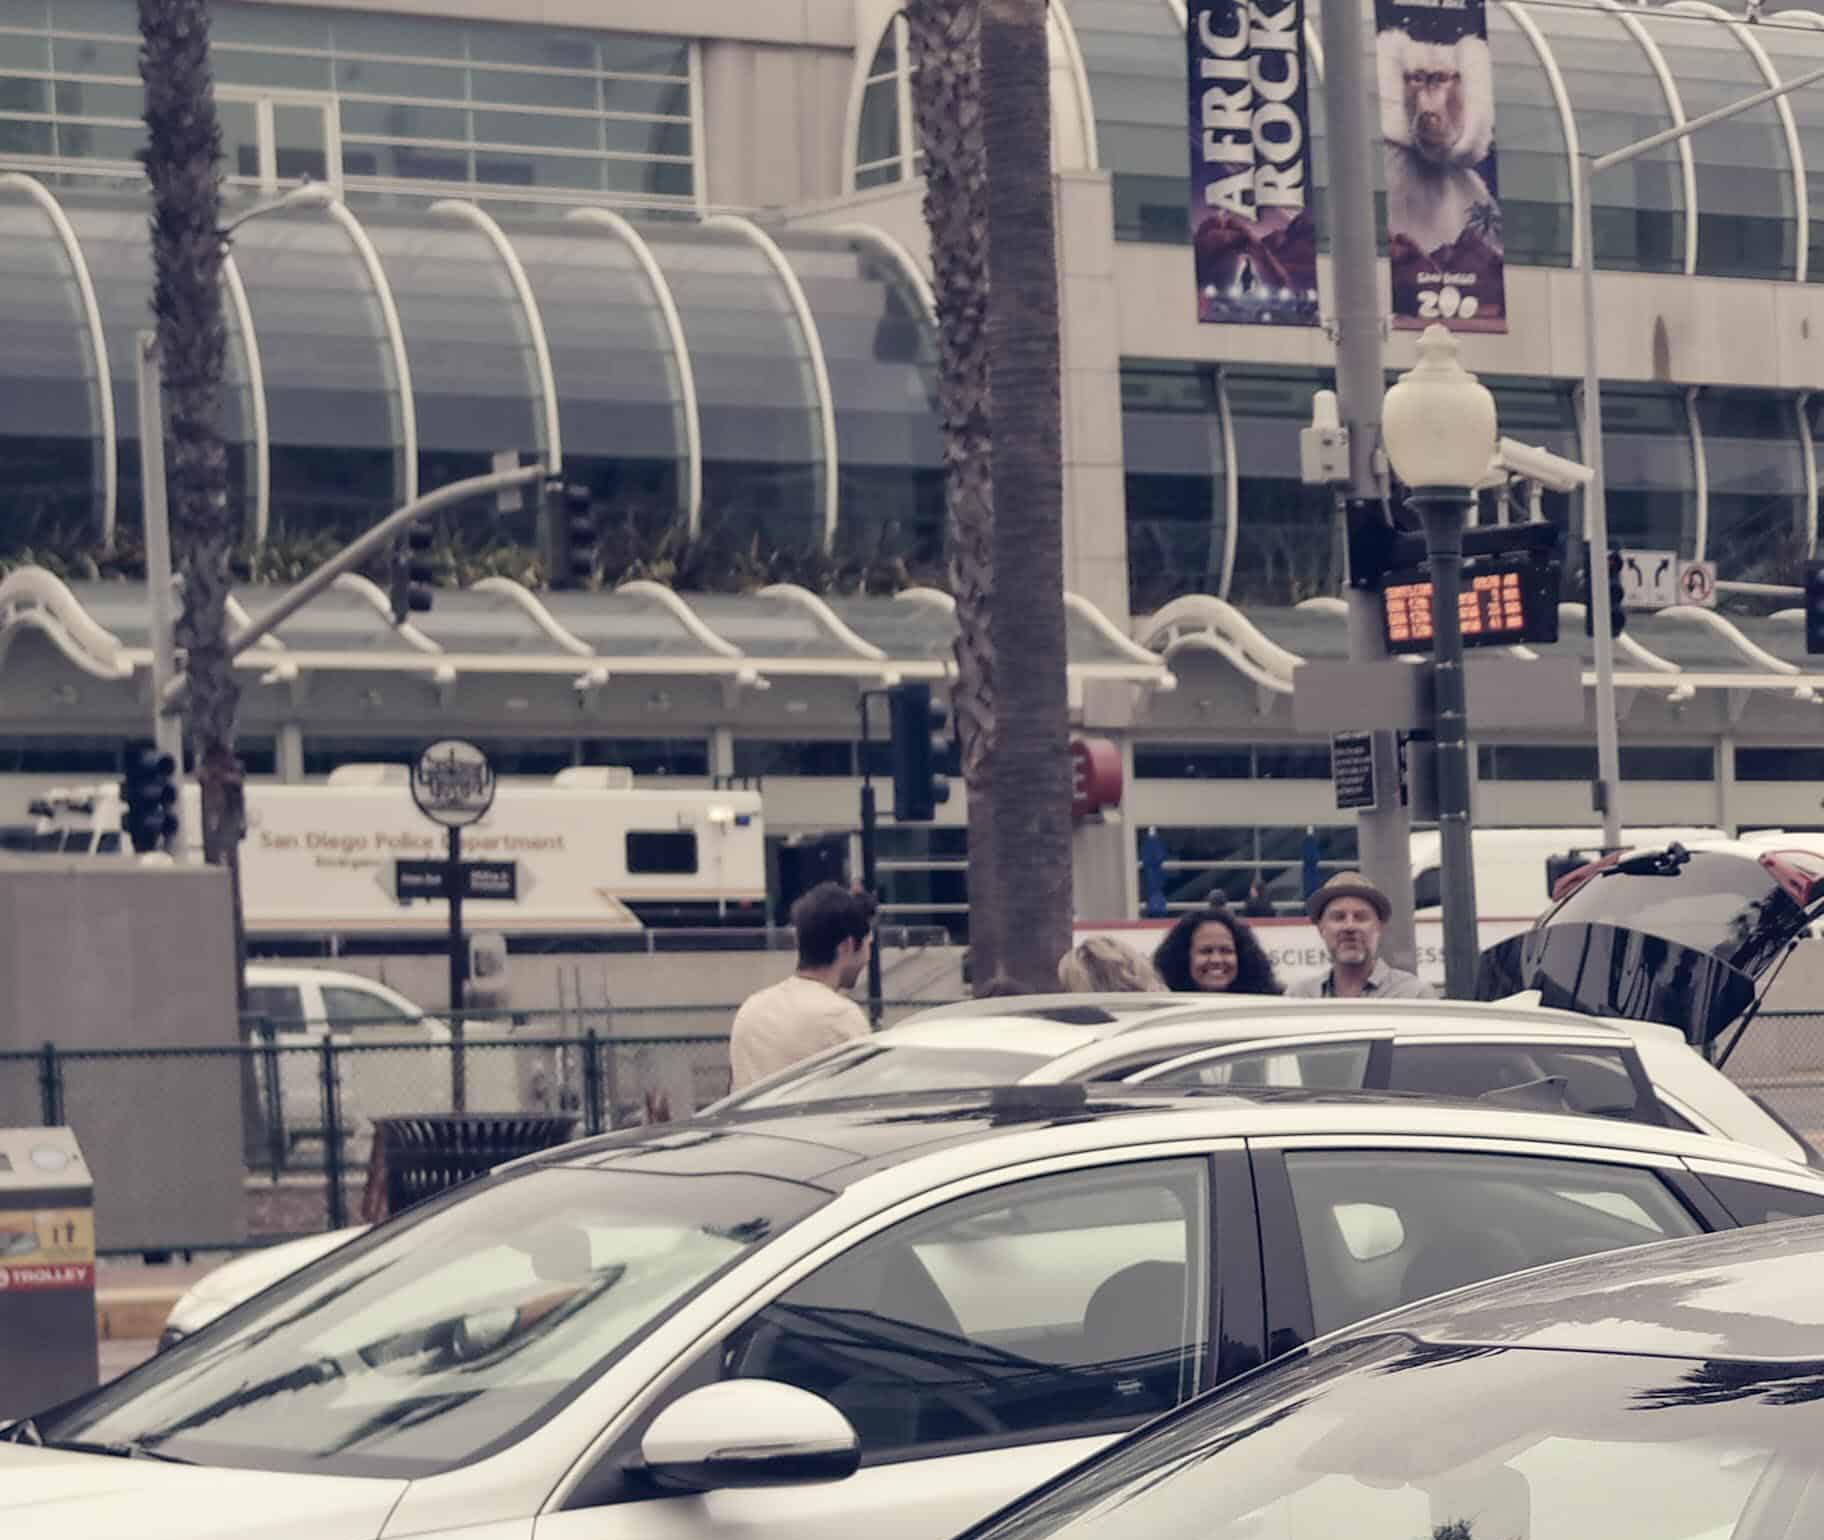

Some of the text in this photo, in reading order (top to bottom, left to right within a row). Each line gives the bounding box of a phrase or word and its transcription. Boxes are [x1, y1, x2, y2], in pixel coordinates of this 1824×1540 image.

[1199, 0, 1258, 222] AFRIC
[261, 830, 566, 853] San Diego Police Dpartment
[13, 1267, 88, 1283] TROLLEY
